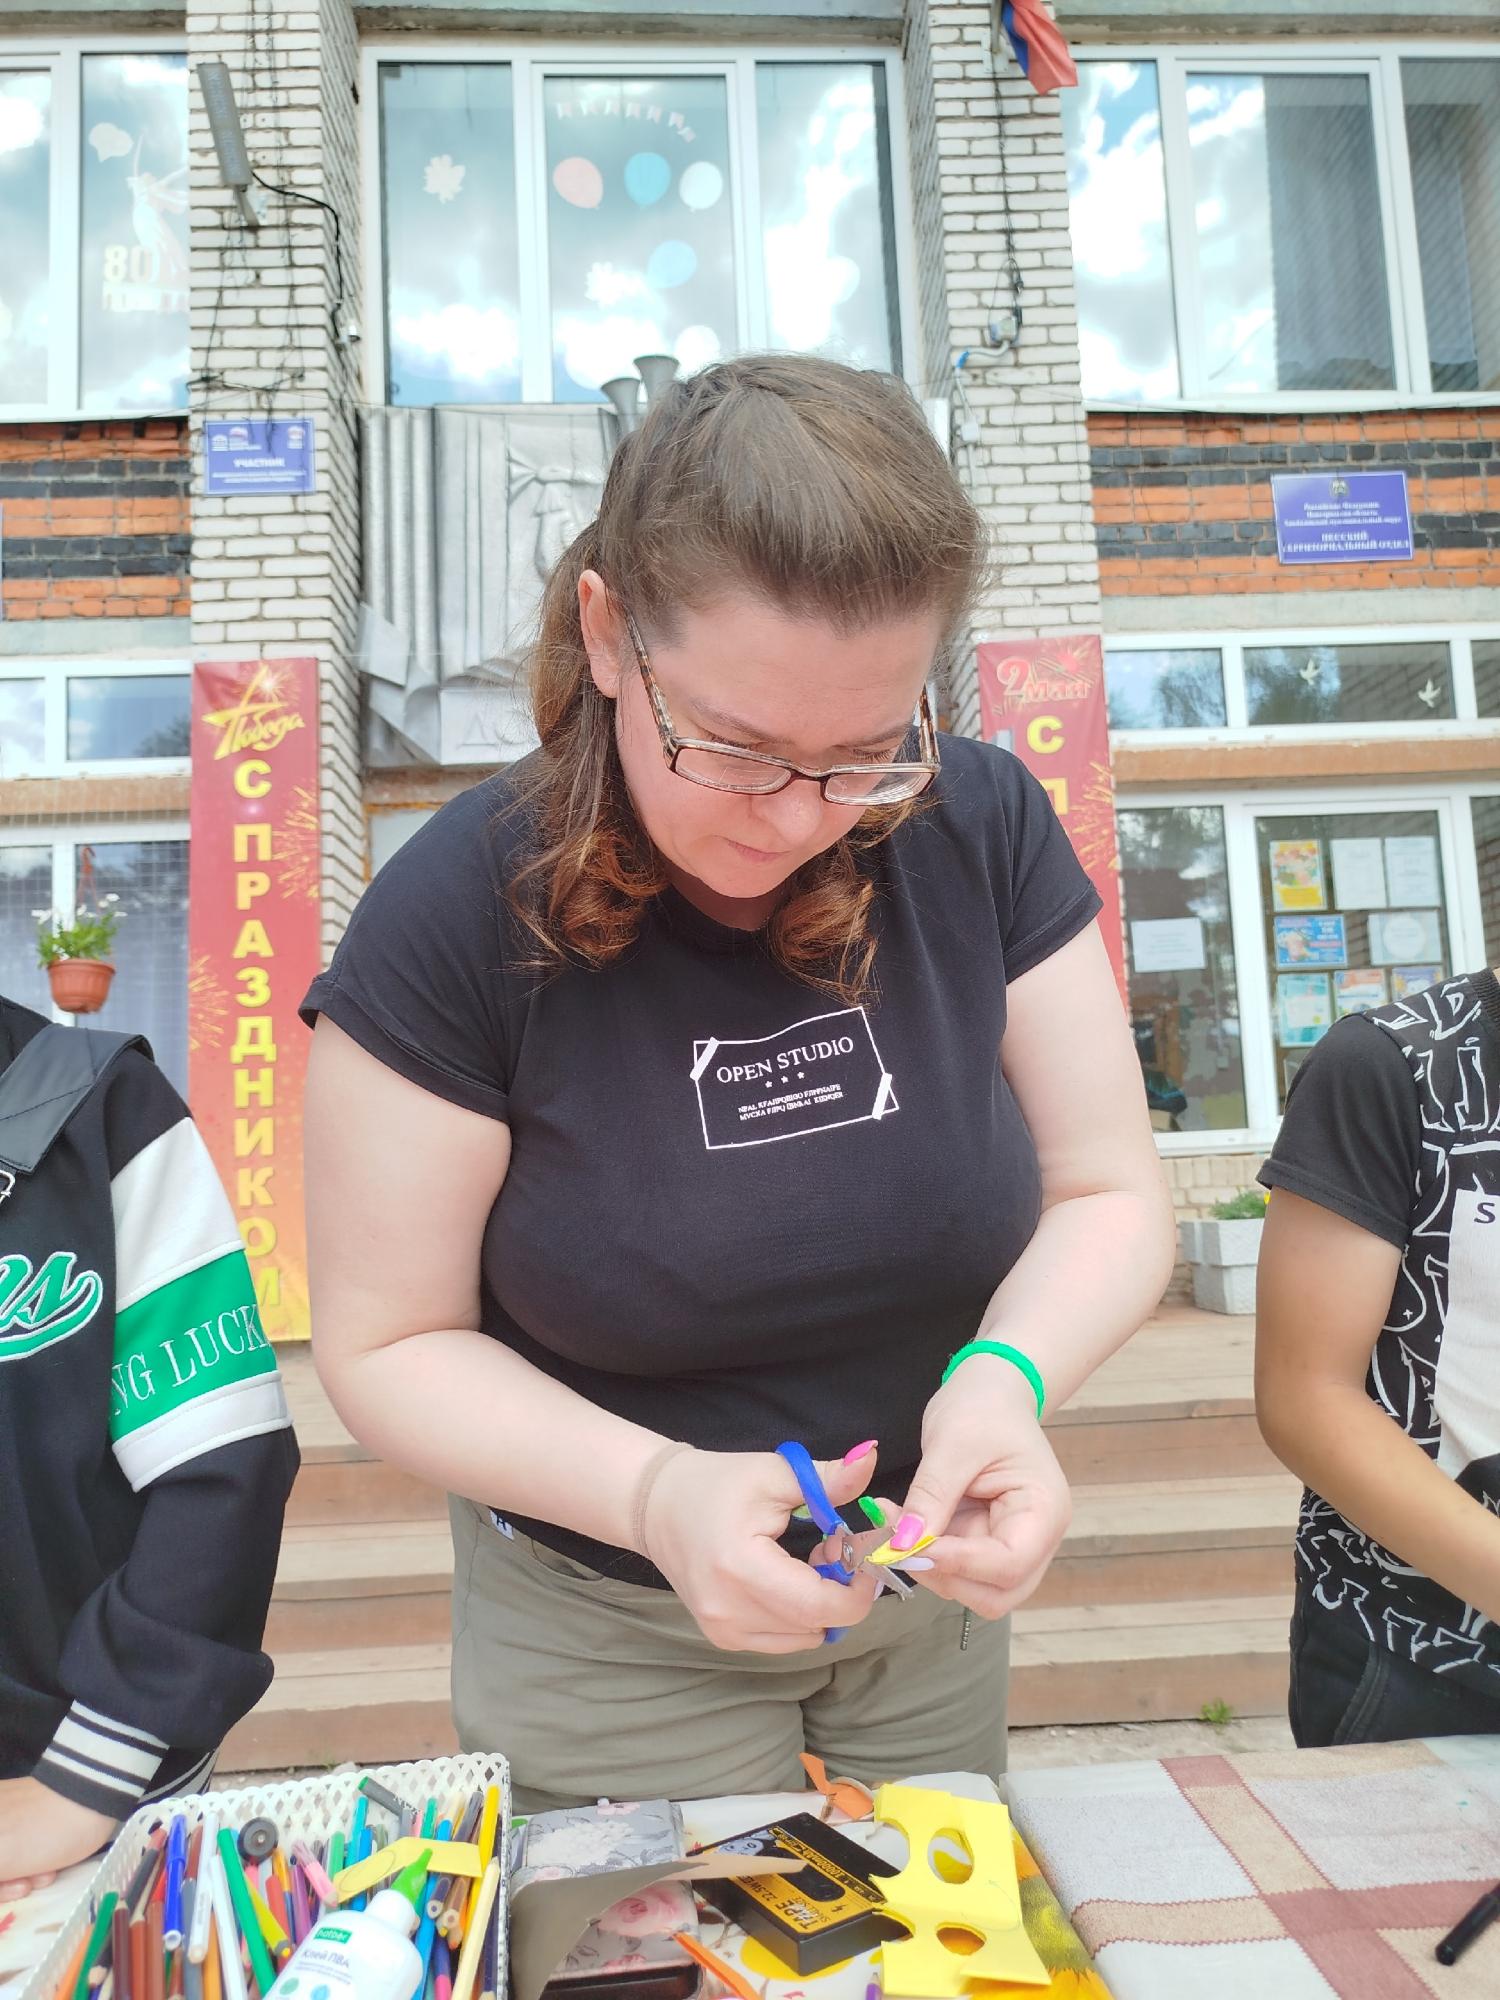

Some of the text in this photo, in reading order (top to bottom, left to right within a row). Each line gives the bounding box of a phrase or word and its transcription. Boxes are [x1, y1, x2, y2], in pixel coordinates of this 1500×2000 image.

[1026, 715, 1065, 754] С
[233, 758, 273, 799] С
[716, 1036, 854, 1083] OPEN STUDIO
[776, 1899, 819, 1931] TAPE
